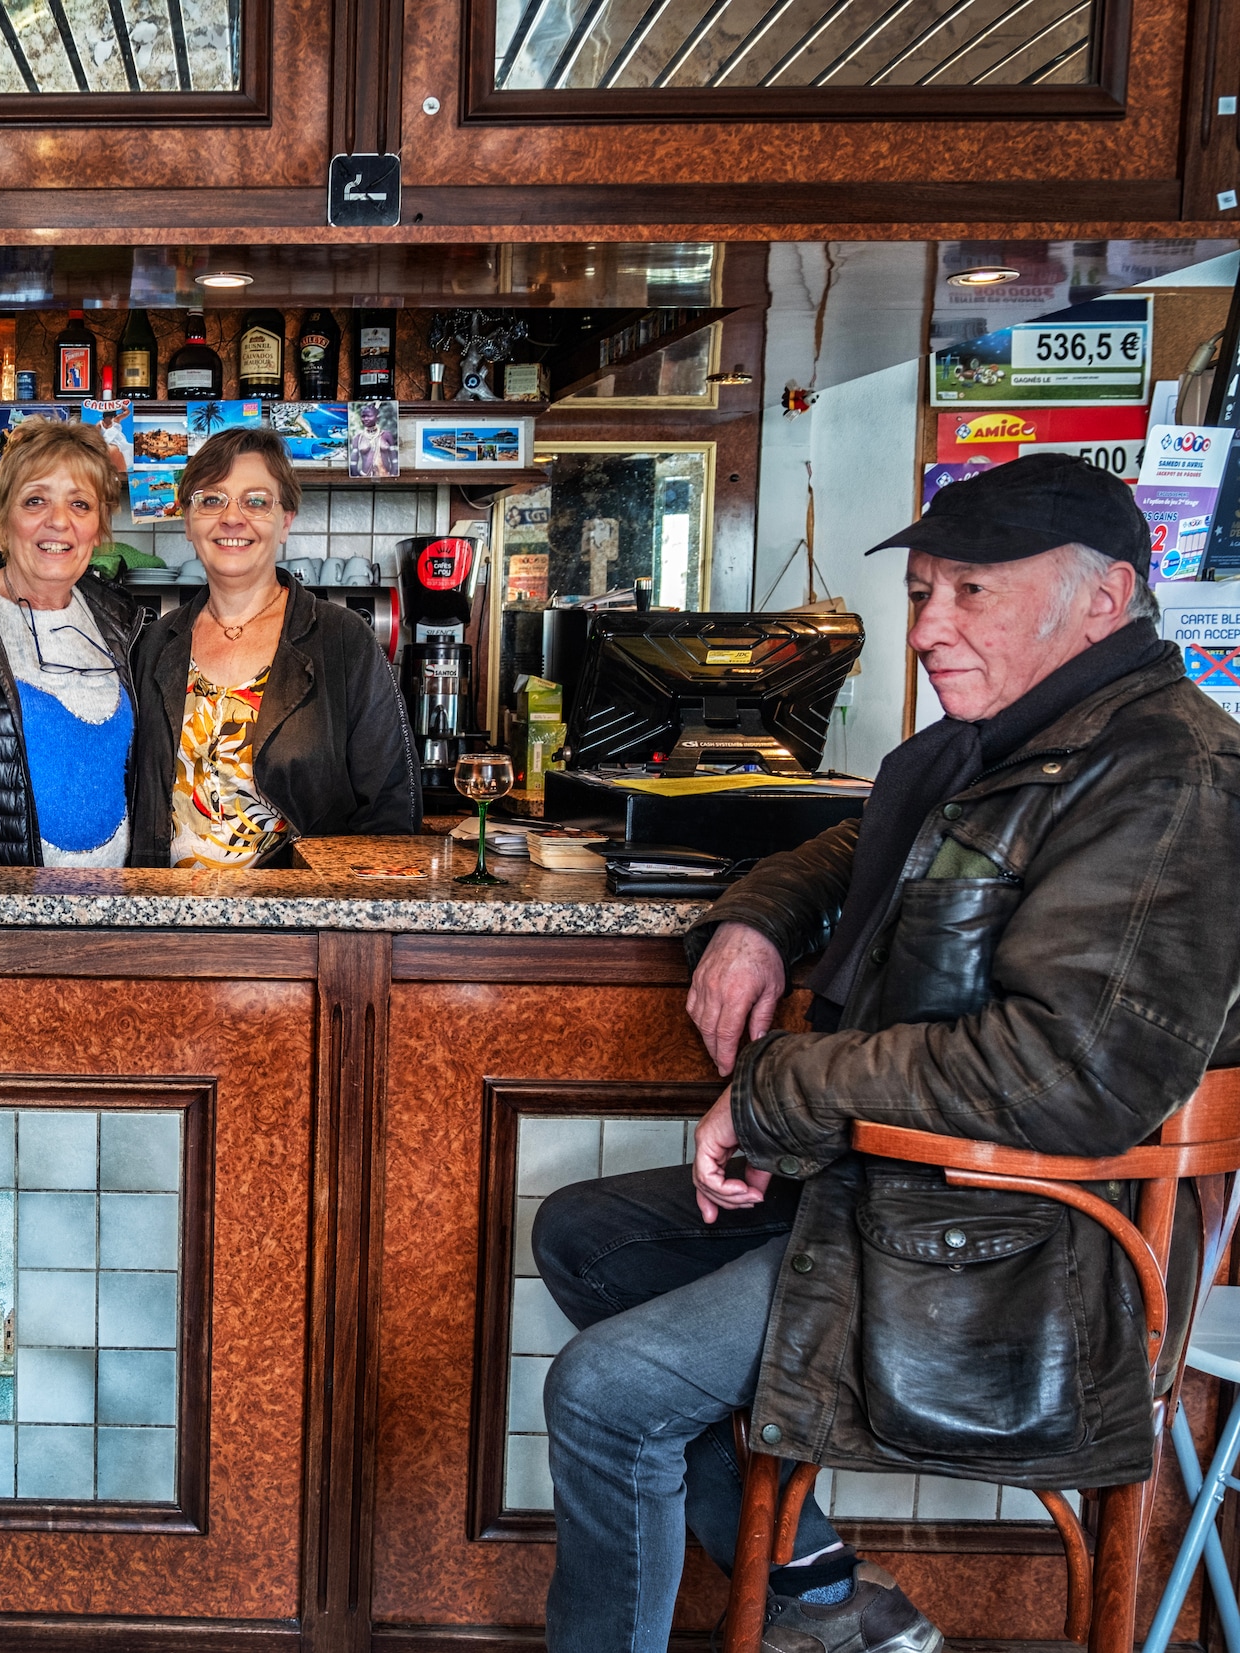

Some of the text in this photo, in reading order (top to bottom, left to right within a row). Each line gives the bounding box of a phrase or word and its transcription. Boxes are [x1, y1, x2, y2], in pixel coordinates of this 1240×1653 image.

[1036, 331, 1140, 366] 536,5 €
[1013, 375, 1042, 384] GAGNÉS
[83, 399, 122, 411] CALINS
[1173, 431, 1212, 452] LOTO
[1158, 460, 1181, 468] SAMEDI
[1153, 512, 1178, 521] GAINS
[1151, 524, 1168, 552] 2
[1180, 613, 1218, 625] CARTE
[1175, 629, 1201, 640] NON
[434, 669, 457, 677] SANTOS
